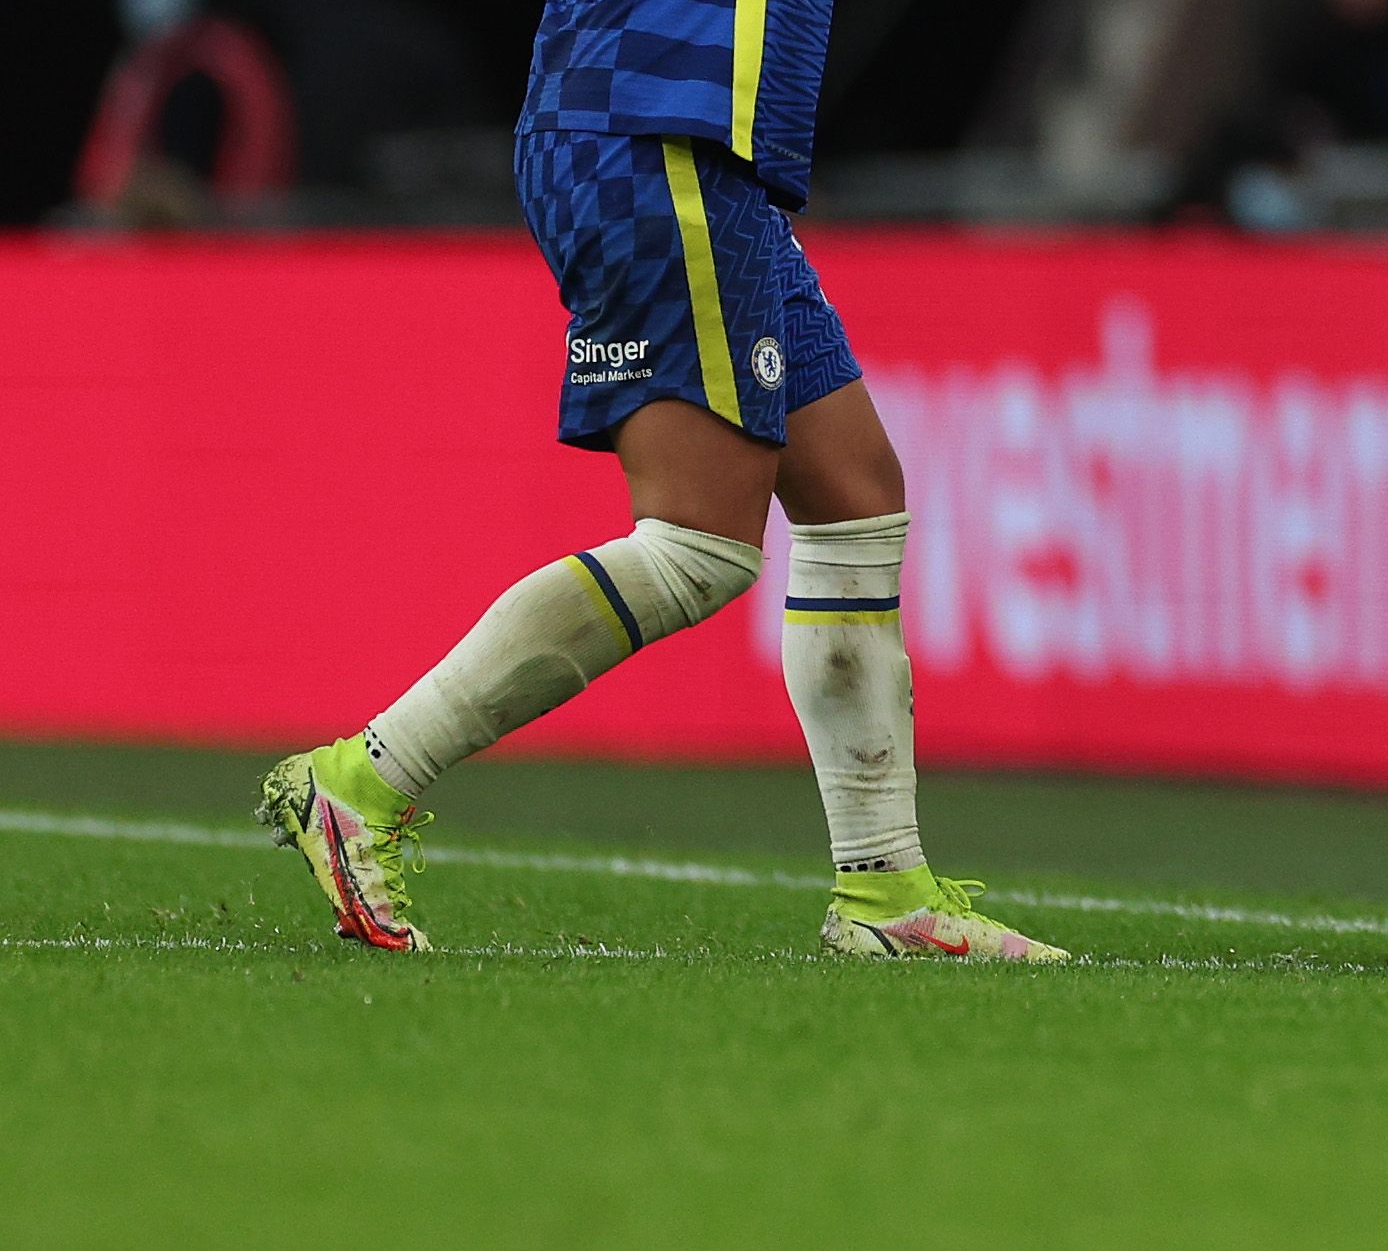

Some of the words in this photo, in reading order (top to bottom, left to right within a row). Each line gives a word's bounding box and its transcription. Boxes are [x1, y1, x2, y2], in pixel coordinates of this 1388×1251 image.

[570, 338, 649, 368] Singer
[570, 370, 606, 386] Capital
[607, 368, 653, 382] Markets
